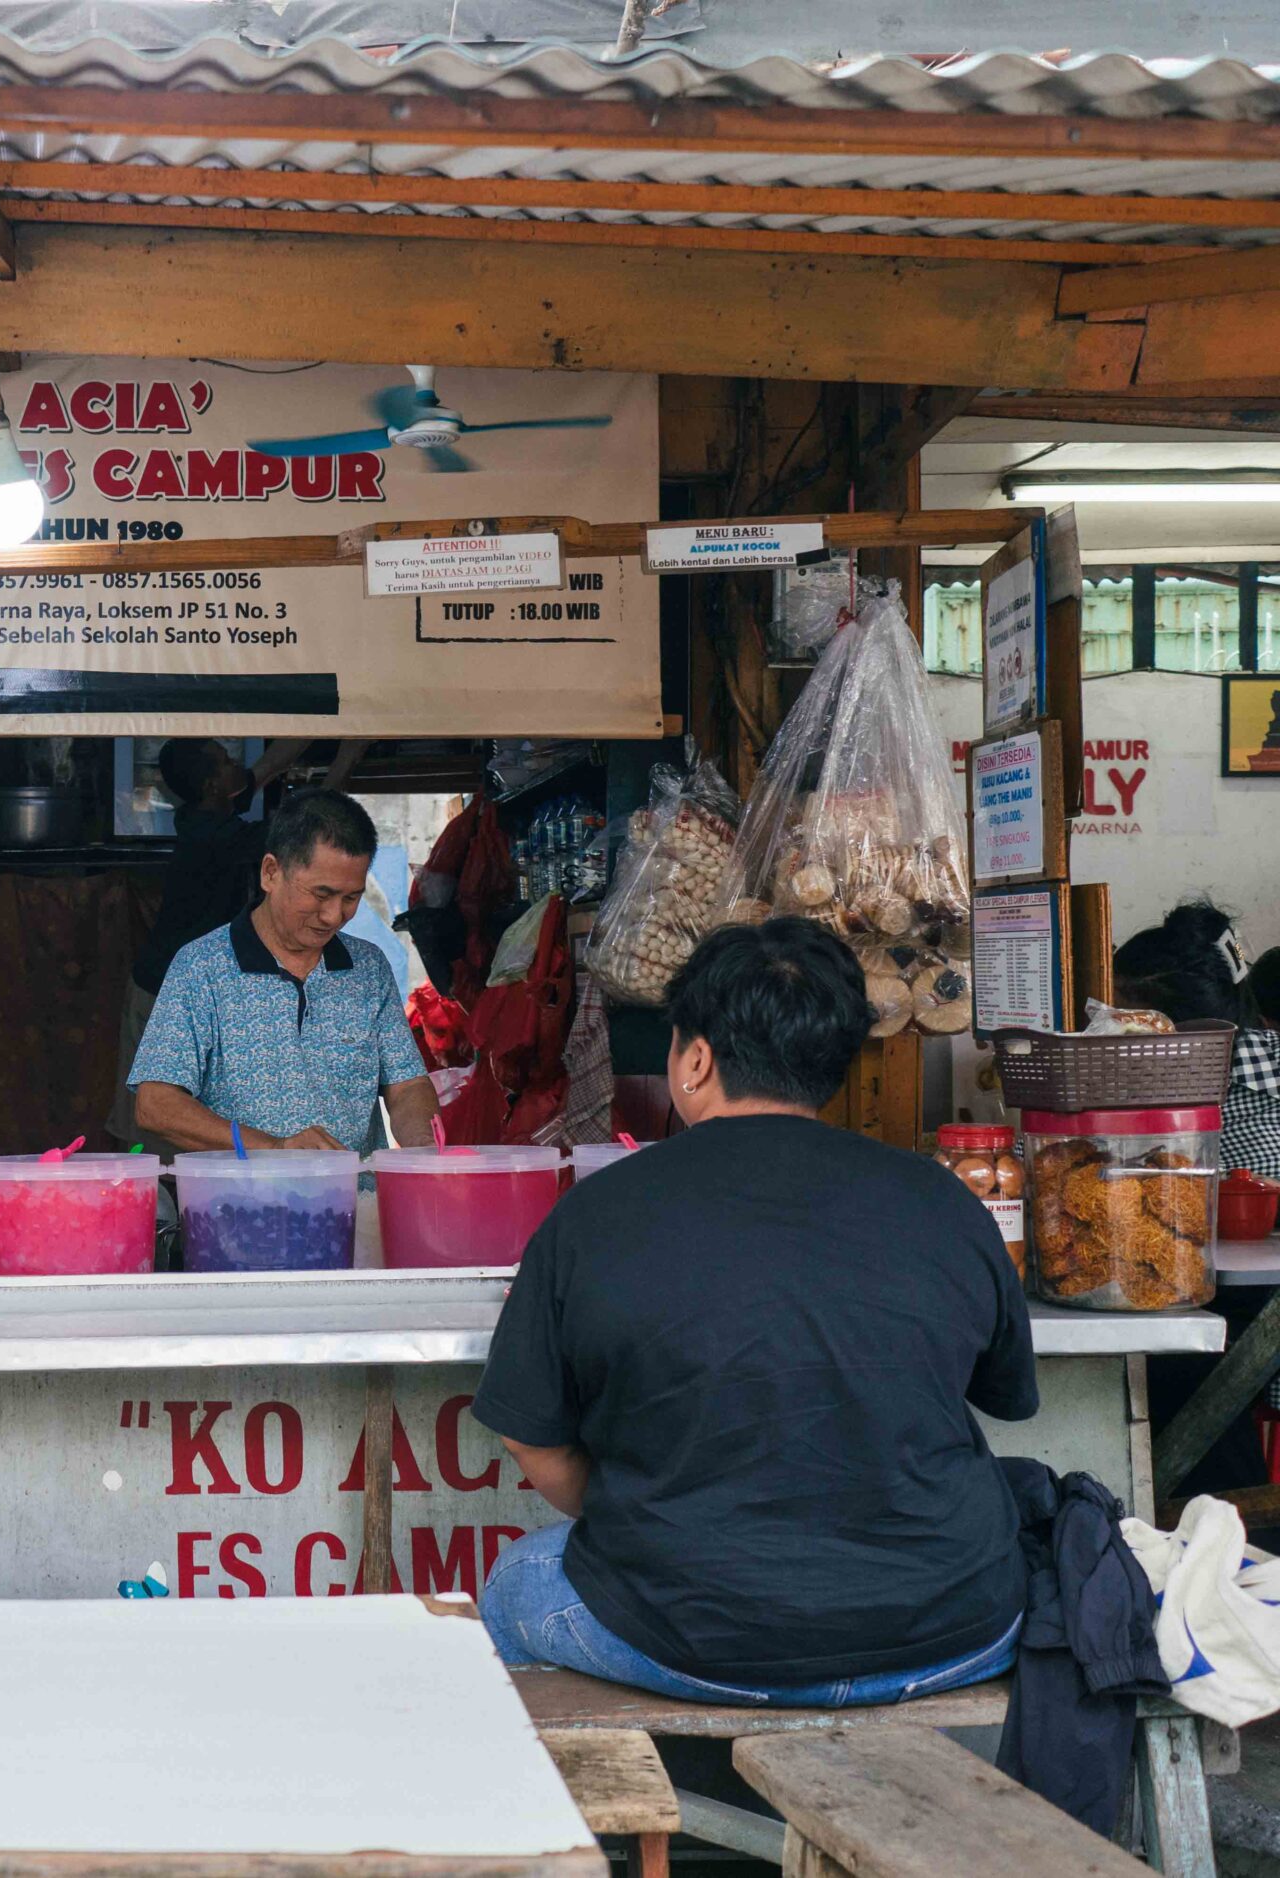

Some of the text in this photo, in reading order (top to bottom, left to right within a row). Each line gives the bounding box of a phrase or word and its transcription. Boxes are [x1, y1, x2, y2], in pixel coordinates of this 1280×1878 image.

[92, 448, 386, 502] CAMPUR
[32, 518, 108, 540] HUN
[117, 520, 183, 541] 1980
[695, 528, 729, 539] MENU
[732, 527, 768, 537] BARU
[422, 540, 484, 552] ATTENTION
[690, 542, 780, 553] ALPUKAT KOCOK
[374, 551, 552, 569] Sorry Guys, untuk pengambilan VIDEO
[649, 555, 794, 568] (Lebih kental dan Lebih berasa
[102, 572, 261, 589] 0857.1565.0056
[394, 570, 420, 580] harus
[422, 567, 464, 578] DIATAS
[464, 566, 489, 577] JAM
[385, 577, 541, 593] Terima Kasih untuk pengertiannya
[569, 574, 604, 591] WIB
[38, 602, 92, 623] Raya,
[98, 601, 172, 619] Loksem
[177, 602, 199, 620] JP
[205, 602, 228, 619] 51
[235, 602, 269, 619] No.
[275, 602, 287, 619] 3
[443, 603, 495, 621] TUTUP
[518, 603, 563, 621] 18.00
[566, 603, 600, 620] WIB
[81, 626, 158, 644] Sekolah
[164, 627, 221, 644] Santo
[227, 626, 297, 647] Yoseph
[977, 756, 996, 771] DISINI
[997, 746, 1032, 766] TERSEDIA
[1083, 740, 1149, 760] AMUR
[995, 769, 1023, 787] KACANG
